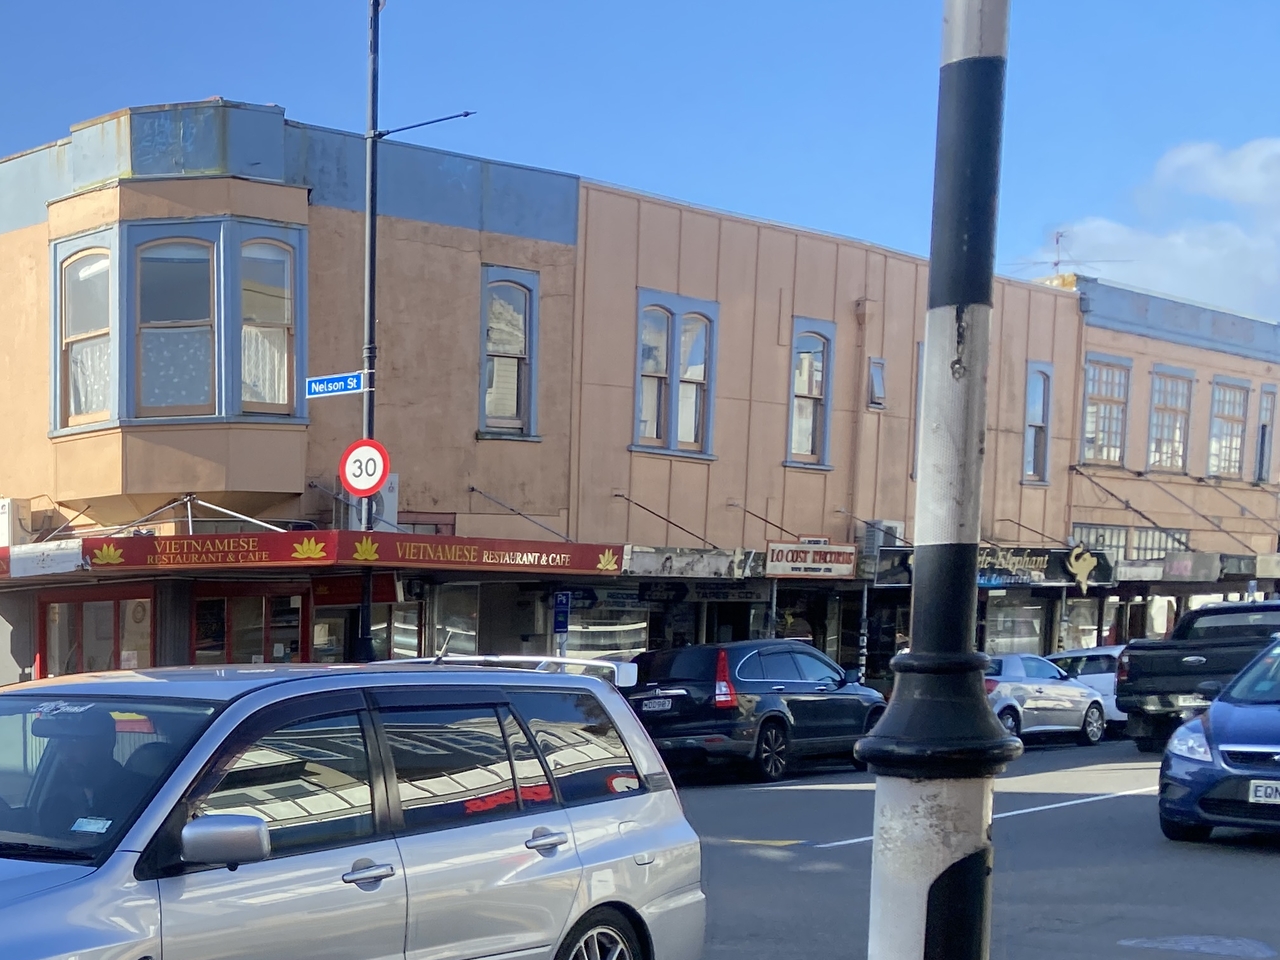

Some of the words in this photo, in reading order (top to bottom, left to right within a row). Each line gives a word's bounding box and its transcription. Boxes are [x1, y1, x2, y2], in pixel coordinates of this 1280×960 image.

[311, 381, 345, 393] Nelson
[347, 377, 357, 389] St
[352, 458, 377, 479] 30
[154, 537, 259, 553] VIETNAMESE
[147, 552, 223, 565] RESTAURANT
[227, 552, 235, 562] &
[239, 551, 270, 563] CAFE
[395, 541, 478, 562] VIETNAMESE
[482, 550, 540, 566] RESTAURANT
[540, 552, 548, 566] &
[548, 552, 572, 568] CAFE
[786, 549, 810, 563] COST
